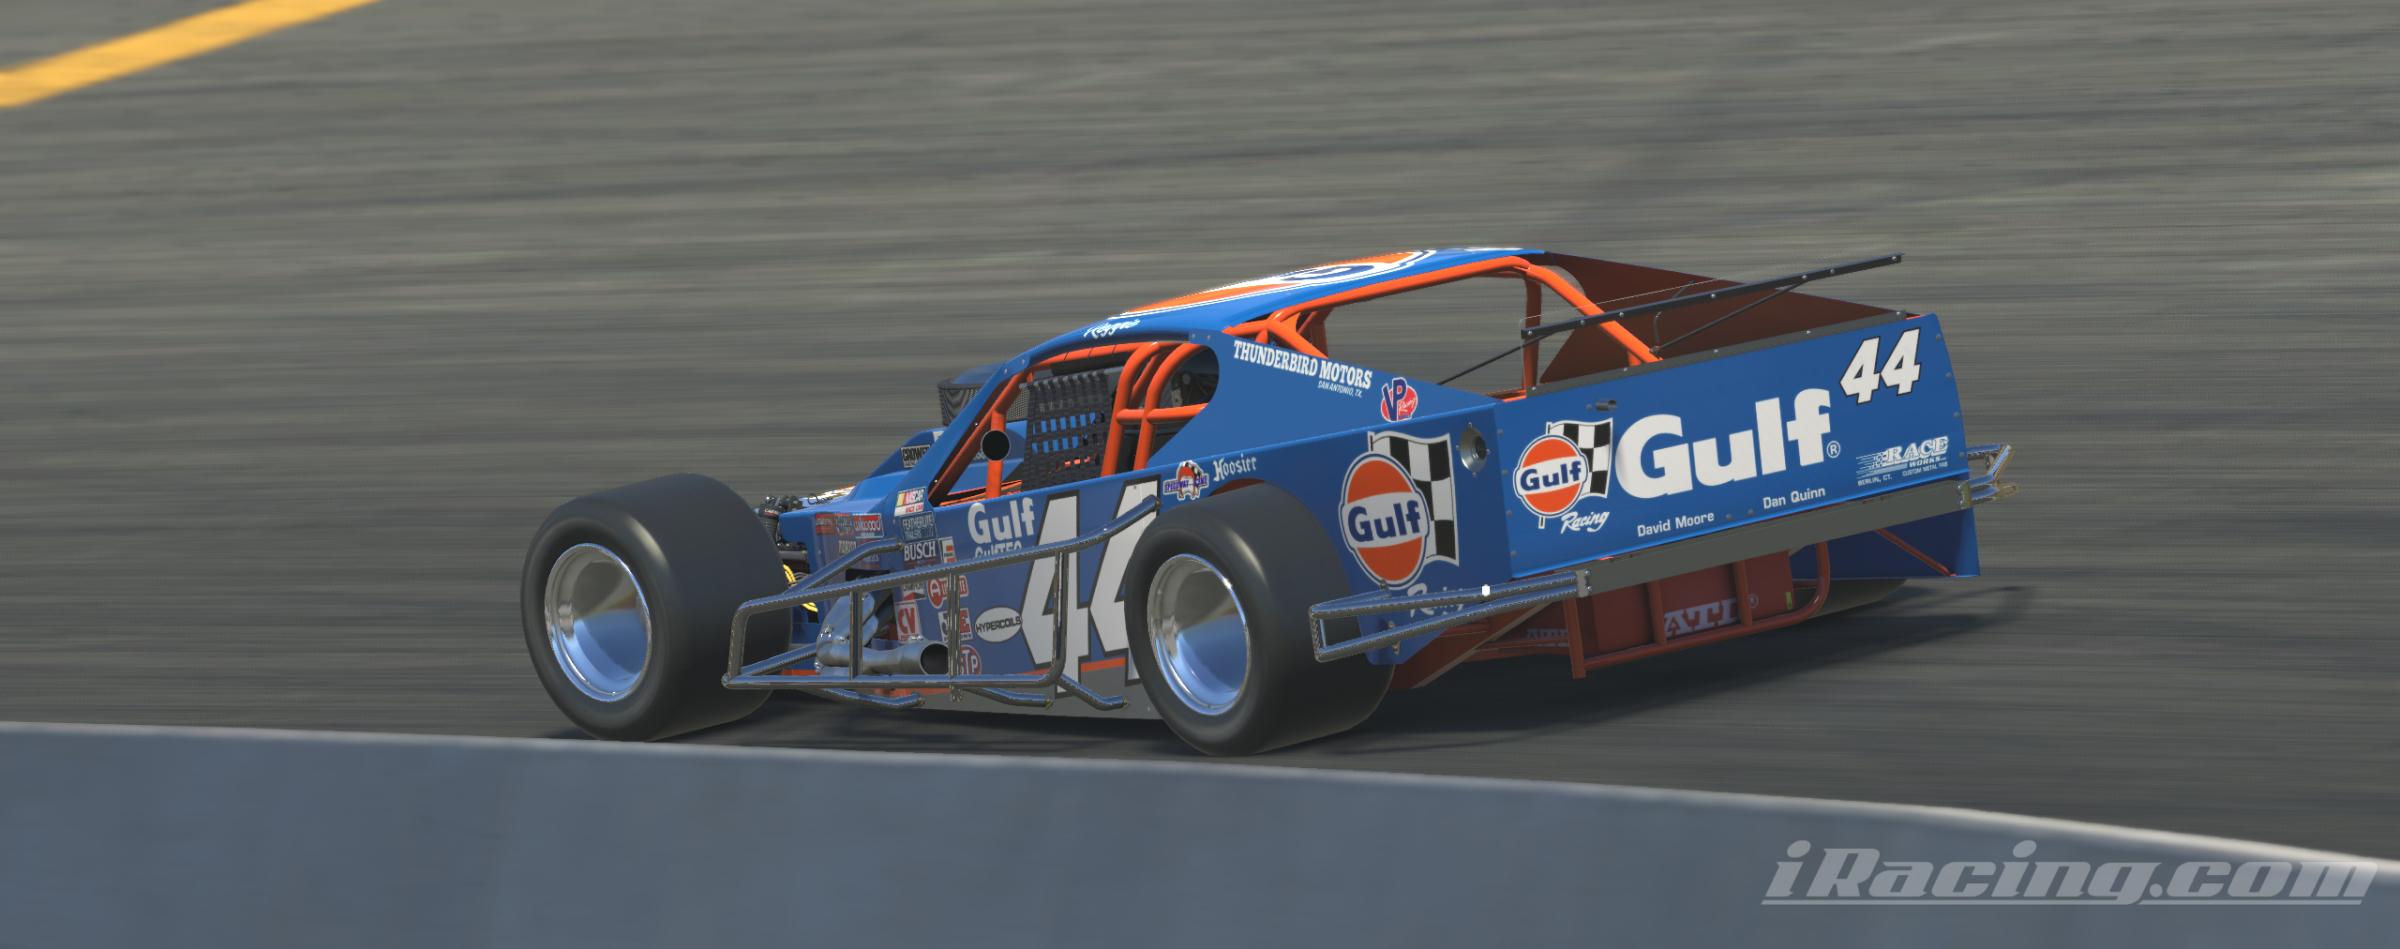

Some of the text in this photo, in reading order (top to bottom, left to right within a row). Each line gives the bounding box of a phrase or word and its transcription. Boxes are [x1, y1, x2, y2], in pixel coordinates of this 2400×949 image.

[1234, 340, 1373, 390] THUNDERBIRD MOTORS
[1839, 328, 1921, 404] 44
[1382, 377, 1407, 421] VP
[1615, 388, 1831, 499] Gulf
[1882, 436, 1949, 464] RACE
[1213, 453, 1257, 481] Hoosier
[1520, 460, 1582, 492] Gulf
[1763, 486, 1826, 510] Dan Quinn
[968, 497, 1034, 544] Gulf
[1348, 500, 1420, 542] Gulf
[1560, 510, 1610, 534] Racing
[1637, 511, 1714, 537] David Moore
[904, 541, 937, 561] BUSCH
[975, 616, 1022, 633] HYPERCOILS
